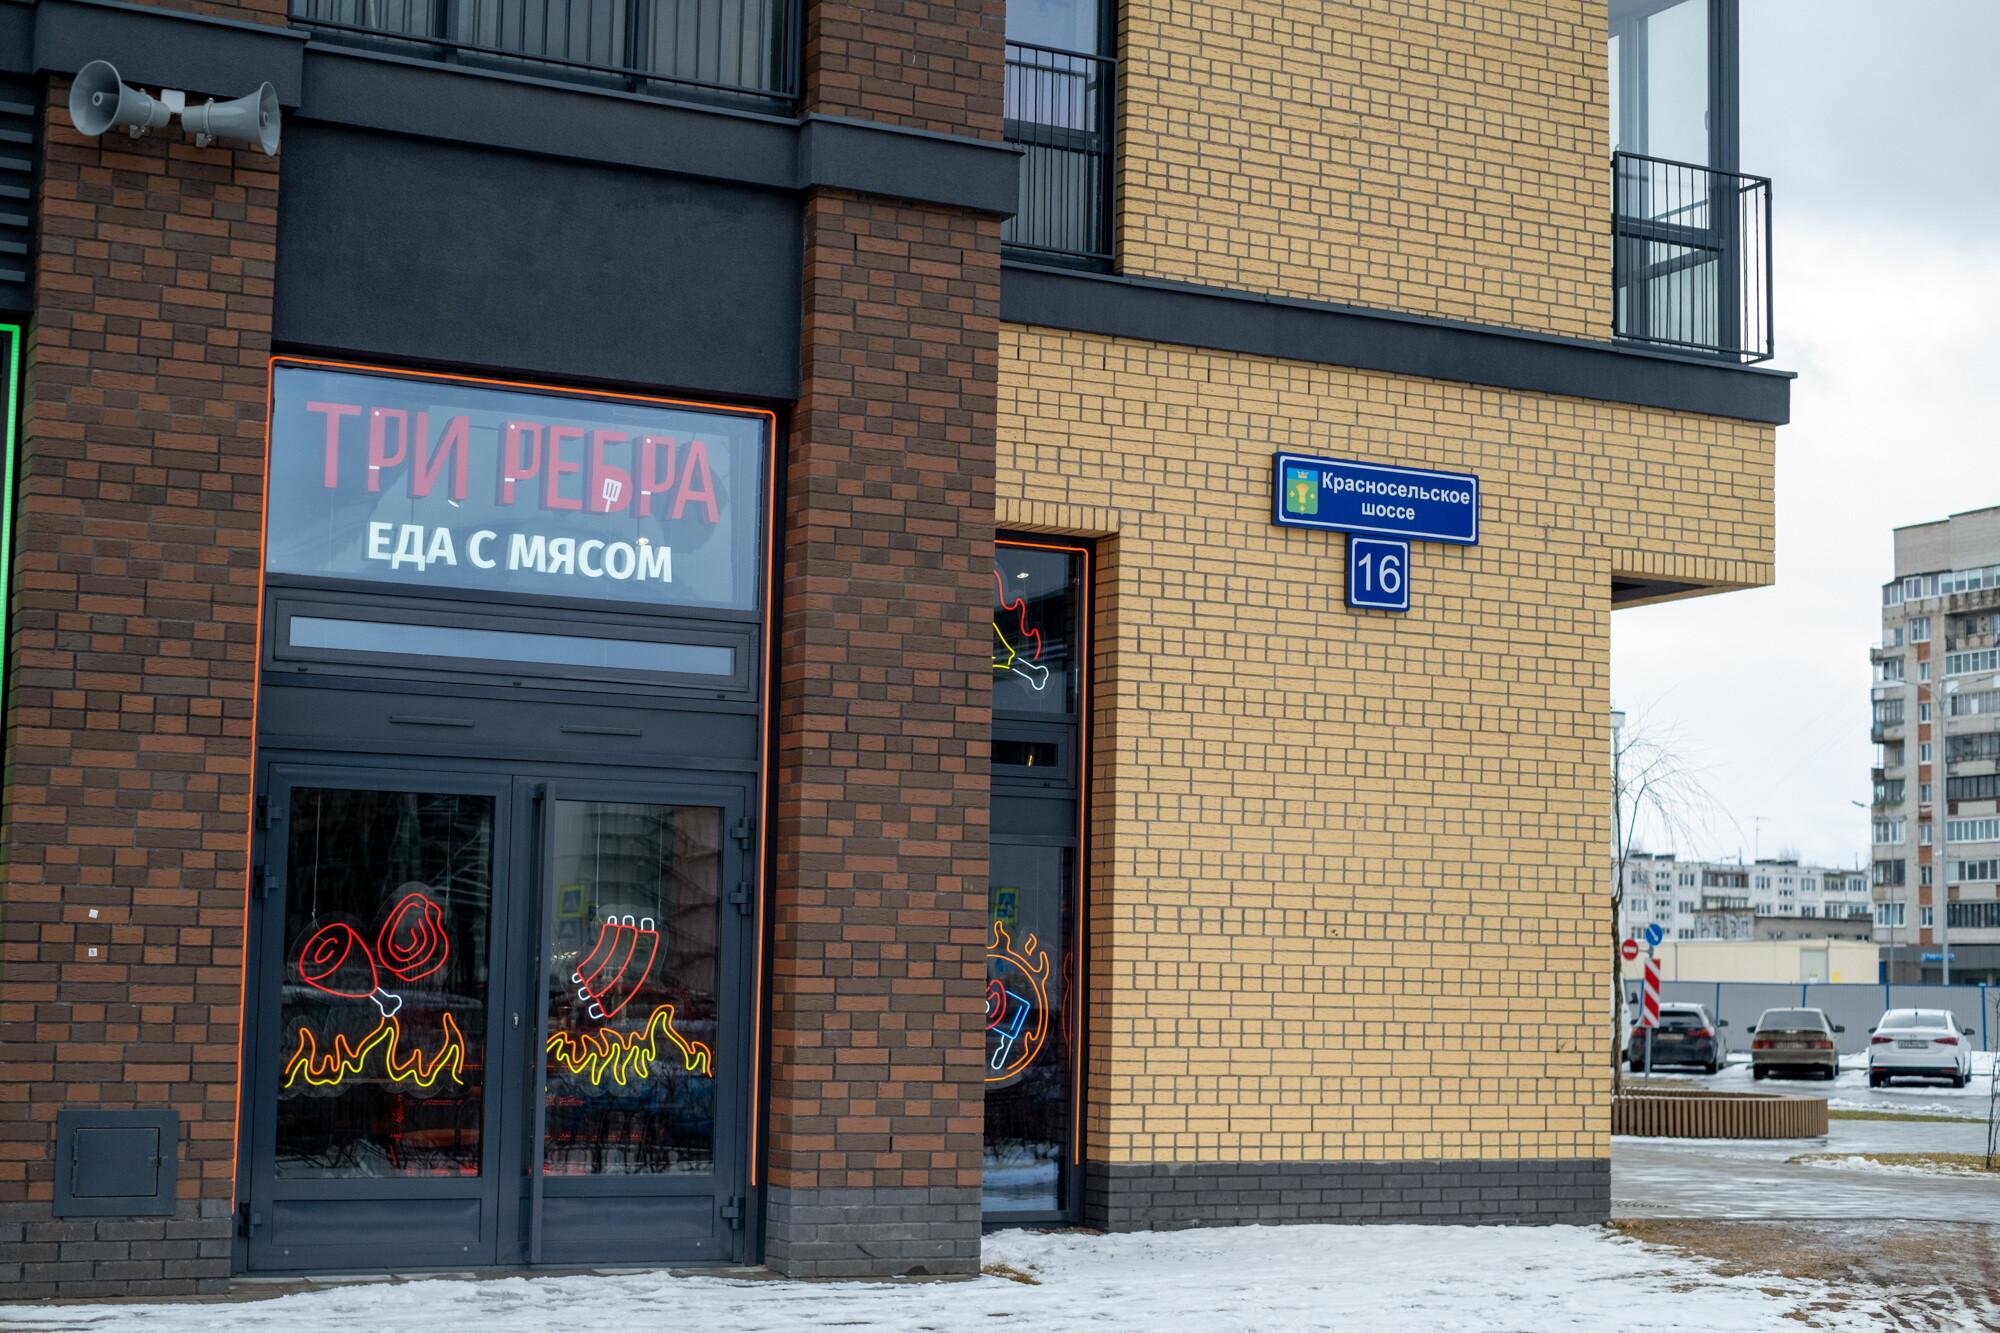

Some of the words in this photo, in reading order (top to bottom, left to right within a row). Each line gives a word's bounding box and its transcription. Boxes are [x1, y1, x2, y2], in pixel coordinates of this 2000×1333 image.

[306, 401, 470, 500] ТРИ
[499, 421, 720, 524] РЕБРА
[1322, 471, 1471, 505] Красносельское
[1361, 502, 1416, 521] шоссе
[368, 521, 458, 571] ЕДА
[469, 529, 497, 569] С
[508, 533, 673, 583] МЯСОМ
[1358, 552, 1401, 594] 16
